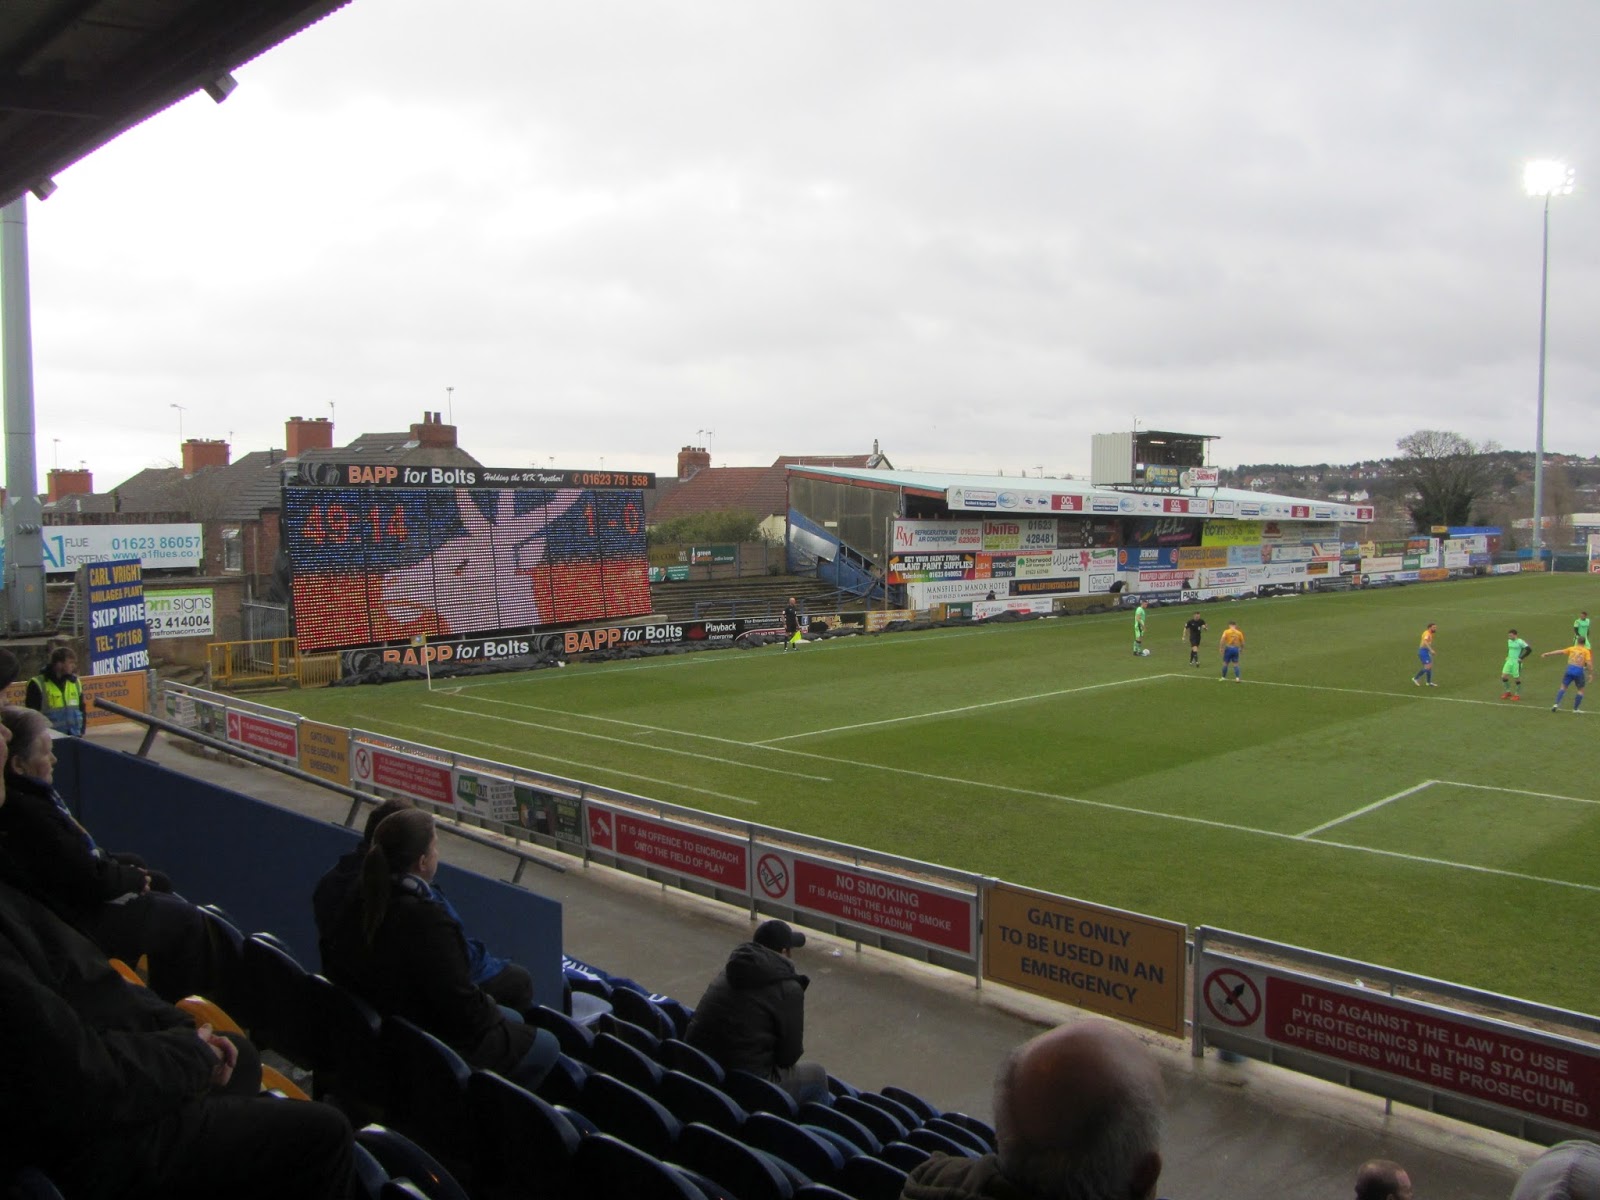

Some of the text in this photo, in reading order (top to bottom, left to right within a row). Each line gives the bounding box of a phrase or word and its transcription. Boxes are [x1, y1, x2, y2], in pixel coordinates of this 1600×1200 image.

[348, 465, 476, 485] BAPP for Bolts
[483, 472, 509, 483] Holding
[582, 473, 648, 487] 01623 751 558
[1028, 520, 1052, 530] 01623
[65, 538, 88, 548] FLUE
[112, 537, 155, 550] 01623
[1025, 533, 1055, 544] 428481
[66, 554, 110, 565] SYSTEMS
[922, 561, 942, 570] PAINT
[943, 561, 974, 570] SUPPLIES
[89, 563, 142, 587] CARL WRIGHT
[123, 585, 143, 599] PLANT
[927, 584, 963, 594] MANSFIELD
[964, 583, 988, 591] MANOR
[989, 582, 1008, 590] HOTEL
[1183, 591, 1199, 599] PARK
[173, 597, 212, 614] signs
[92, 603, 145, 629] SKIP HIRE
[165, 615, 210, 628] 414004
[705, 622, 737, 633] Playback
[95, 634, 114, 653] TEL:
[564, 628, 621, 653] BAPP
[623, 627, 642, 642] for
[645, 624, 683, 640] Bolts
[383, 645, 453, 666] BAPP
[456, 643, 479, 660] for
[484, 641, 530, 657] Bolts
[93, 657, 116, 676] MUCK
[105, 680, 127, 689] ONLY
[107, 689, 129, 698] USED
[621, 824, 739, 864] IT IS AN OFFENCE TO ENCROACH
[634, 840, 725, 875] ONTO THE FIELD OF PLAY
[836, 874, 920, 908] NO SMOKING
[809, 884, 951, 931] IT IS AGAINST THE LAW TO SMOKE
[842, 905, 913, 932] IN THIS STADIUM
[1027, 907, 1131, 948] GATE ONLY
[999, 925, 1164, 985] TO BE USED IN AN
[1020, 957, 1138, 1004] EMERGENCY
[1292, 1007, 1418, 1053] PYROTECHNICS
[1423, 1042, 1439, 1058] IN
[1446, 1048, 1485, 1071] THIS
[1301, 993, 1569, 1075] IT IS AGAINST THE LAW TO USE
[1284, 1023, 1589, 1118] OFFENDERS WILL BE PROSECUTED
